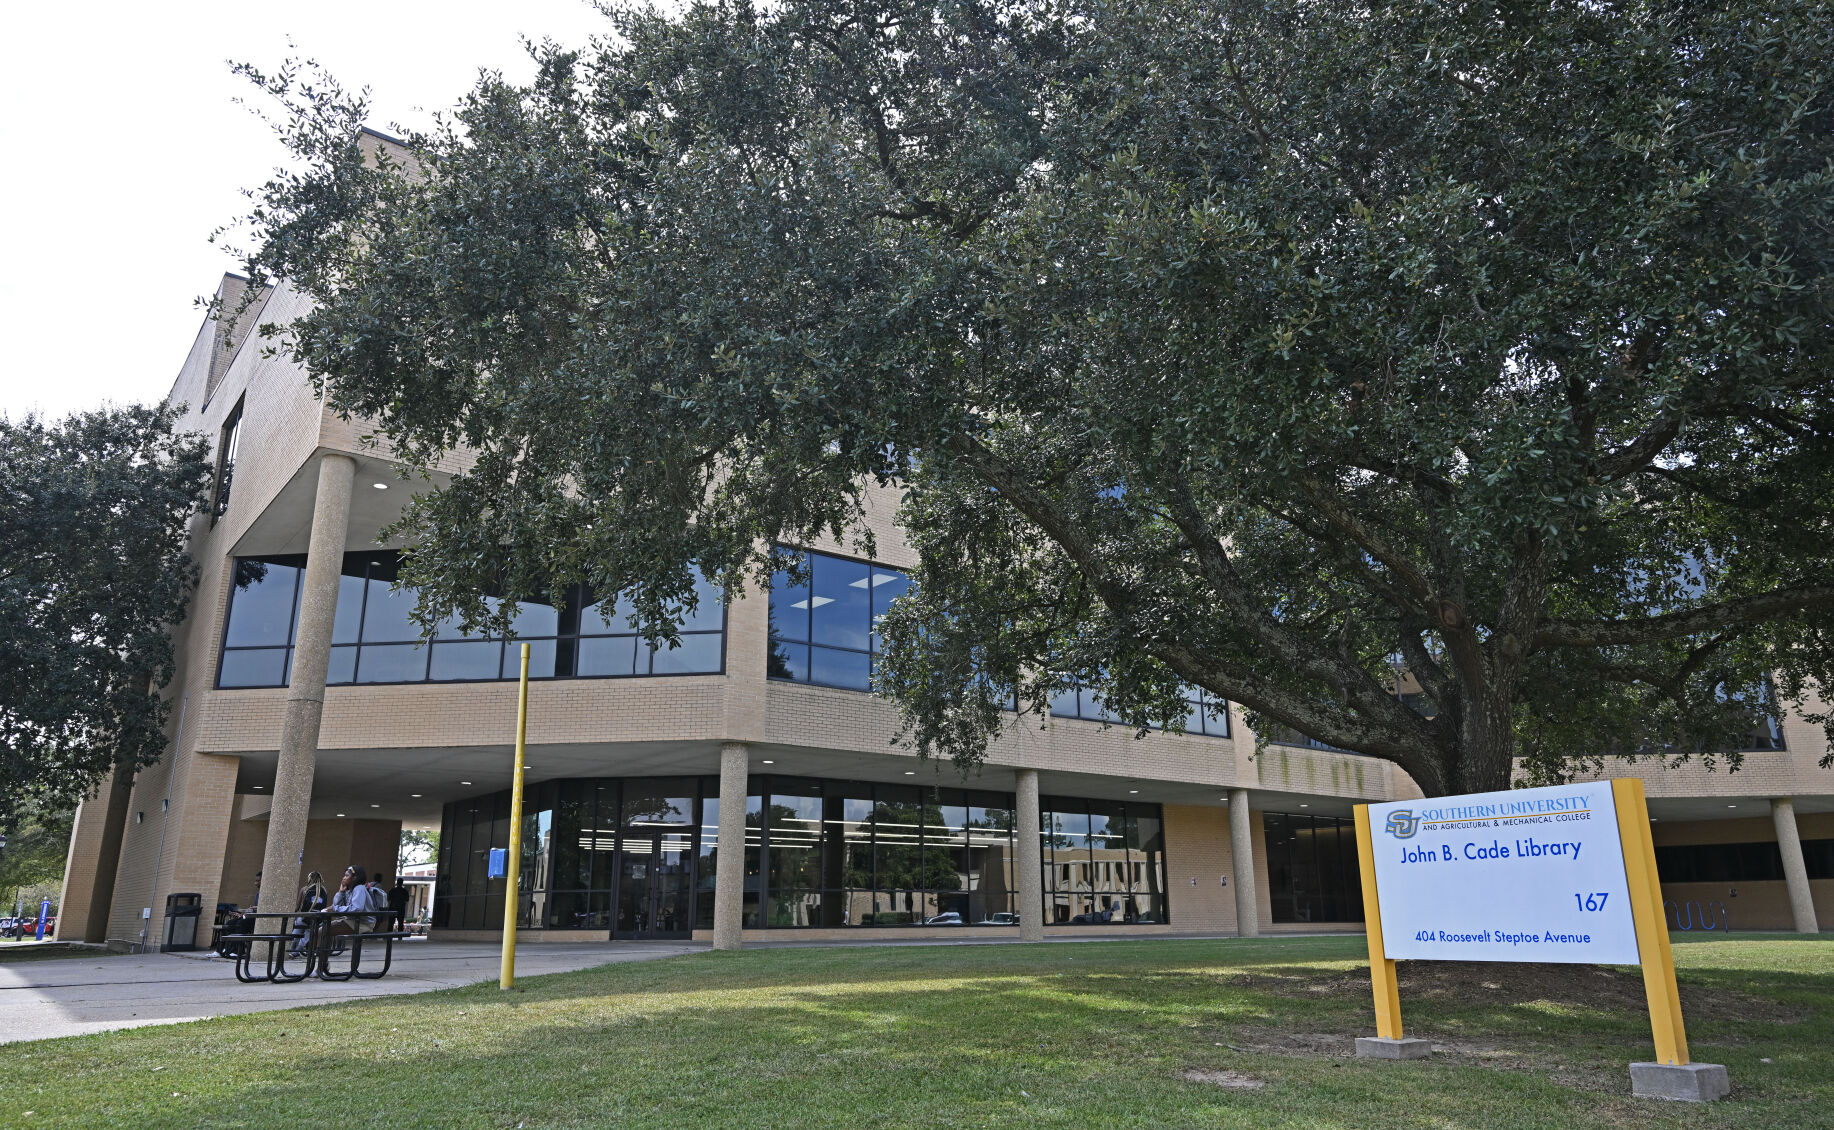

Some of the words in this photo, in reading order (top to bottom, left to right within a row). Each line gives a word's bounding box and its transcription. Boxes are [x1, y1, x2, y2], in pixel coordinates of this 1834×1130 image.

[1422, 804, 1496, 820] SOUTHERN
[1499, 796, 1589, 815] UNIVERSITY
[1422, 823, 1438, 832] AND
[1440, 820, 1490, 830] AGRICULTURAL
[1493, 819, 1500, 827] &
[1502, 816, 1553, 827] MECHANICAL
[1555, 812, 1591, 822] COLLEGE
[1400, 843, 1437, 864] John
[1442, 844, 1458, 862] B.
[1463, 840, 1510, 861] Cade
[1515, 838, 1582, 861] Library
[1574, 892, 1609, 912] 167
[1415, 930, 1436, 944] 404
[1438, 930, 1491, 944] Roosevelt
[1494, 930, 1540, 947] Steptoe
[1543, 930, 1591, 944] Avenue
